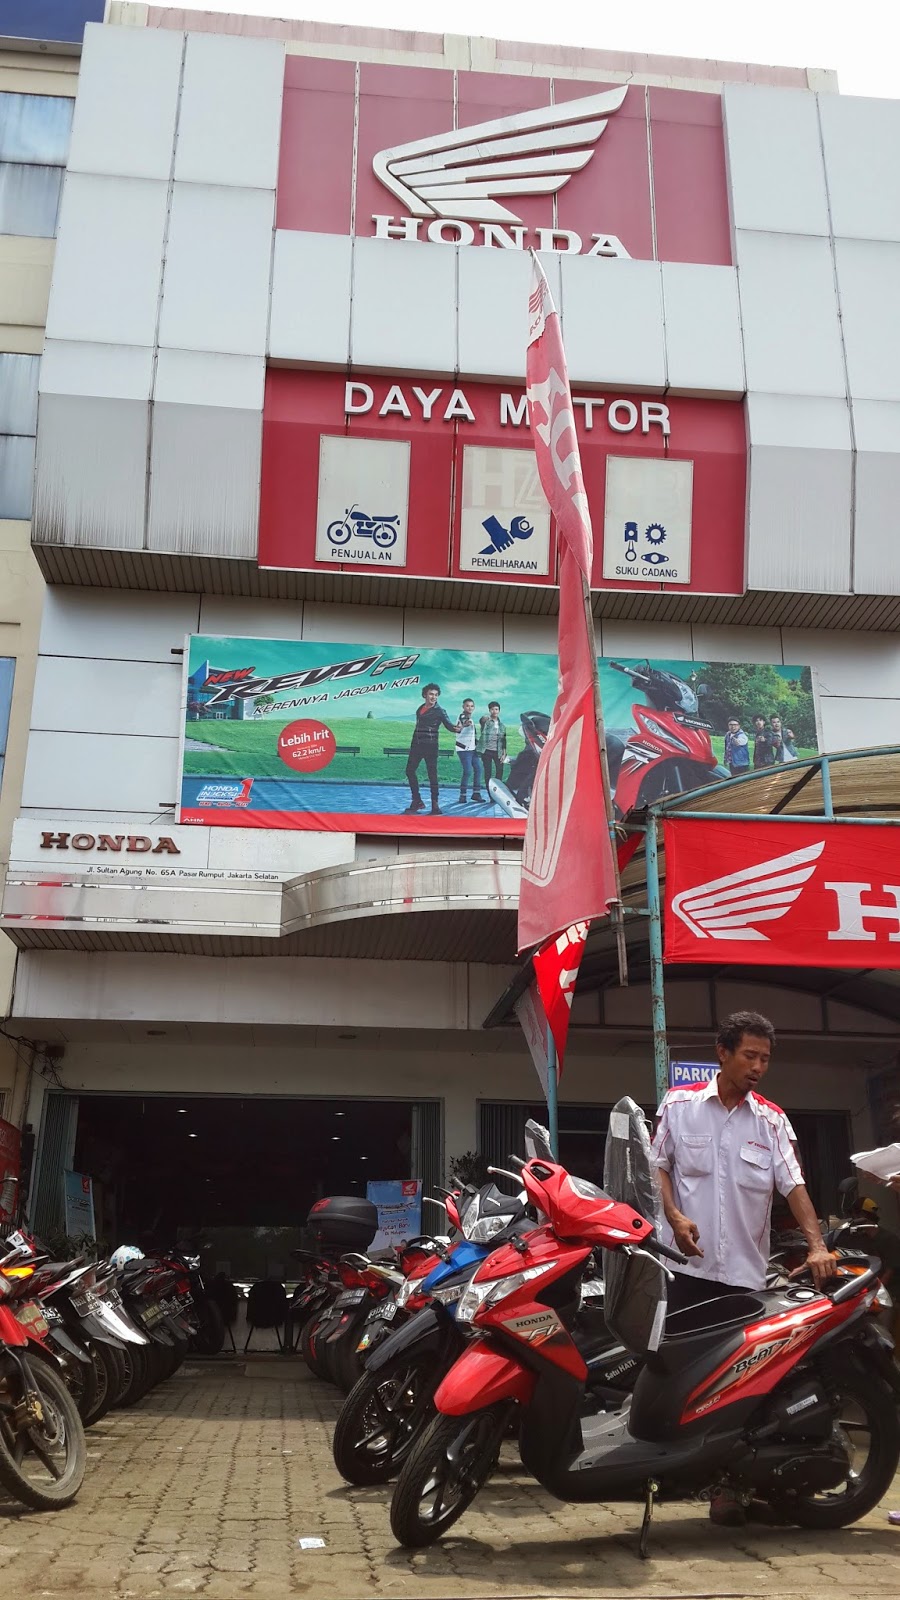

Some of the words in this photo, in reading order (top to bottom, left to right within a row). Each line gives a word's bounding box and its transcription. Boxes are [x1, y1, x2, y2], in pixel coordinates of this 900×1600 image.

[371, 214, 634, 259] HONDA
[344, 382, 476, 423] DAYA
[500, 393, 671, 436] MTOR
[331, 549, 392, 561] PENJUALAN
[471, 558, 538, 570] PEMELIHARAAN
[615, 566, 639, 576] SUKU
[642, 567, 678, 578] CADANG
[203, 666, 256, 687] NEW
[204, 653, 385, 706] REVO
[253, 692, 329, 715] KERENNYA
[333, 681, 388, 700] JAGOAN
[390, 675, 420, 690] KITA
[281, 732, 311, 747] Lebih
[313, 729, 330, 741] Irit
[40, 831, 181, 854] HONDA
[96, 866, 118, 874] Sultan
[119, 867, 142, 876] Agung
[145, 868, 157, 876] No.
[198, 870, 225, 879] Rumput
[227, 871, 252, 879] Jakarta
[254, 872, 279, 880] Selatan
[516, 1314, 553, 1328] HONDA
[604, 1369, 620, 1381] Satu
